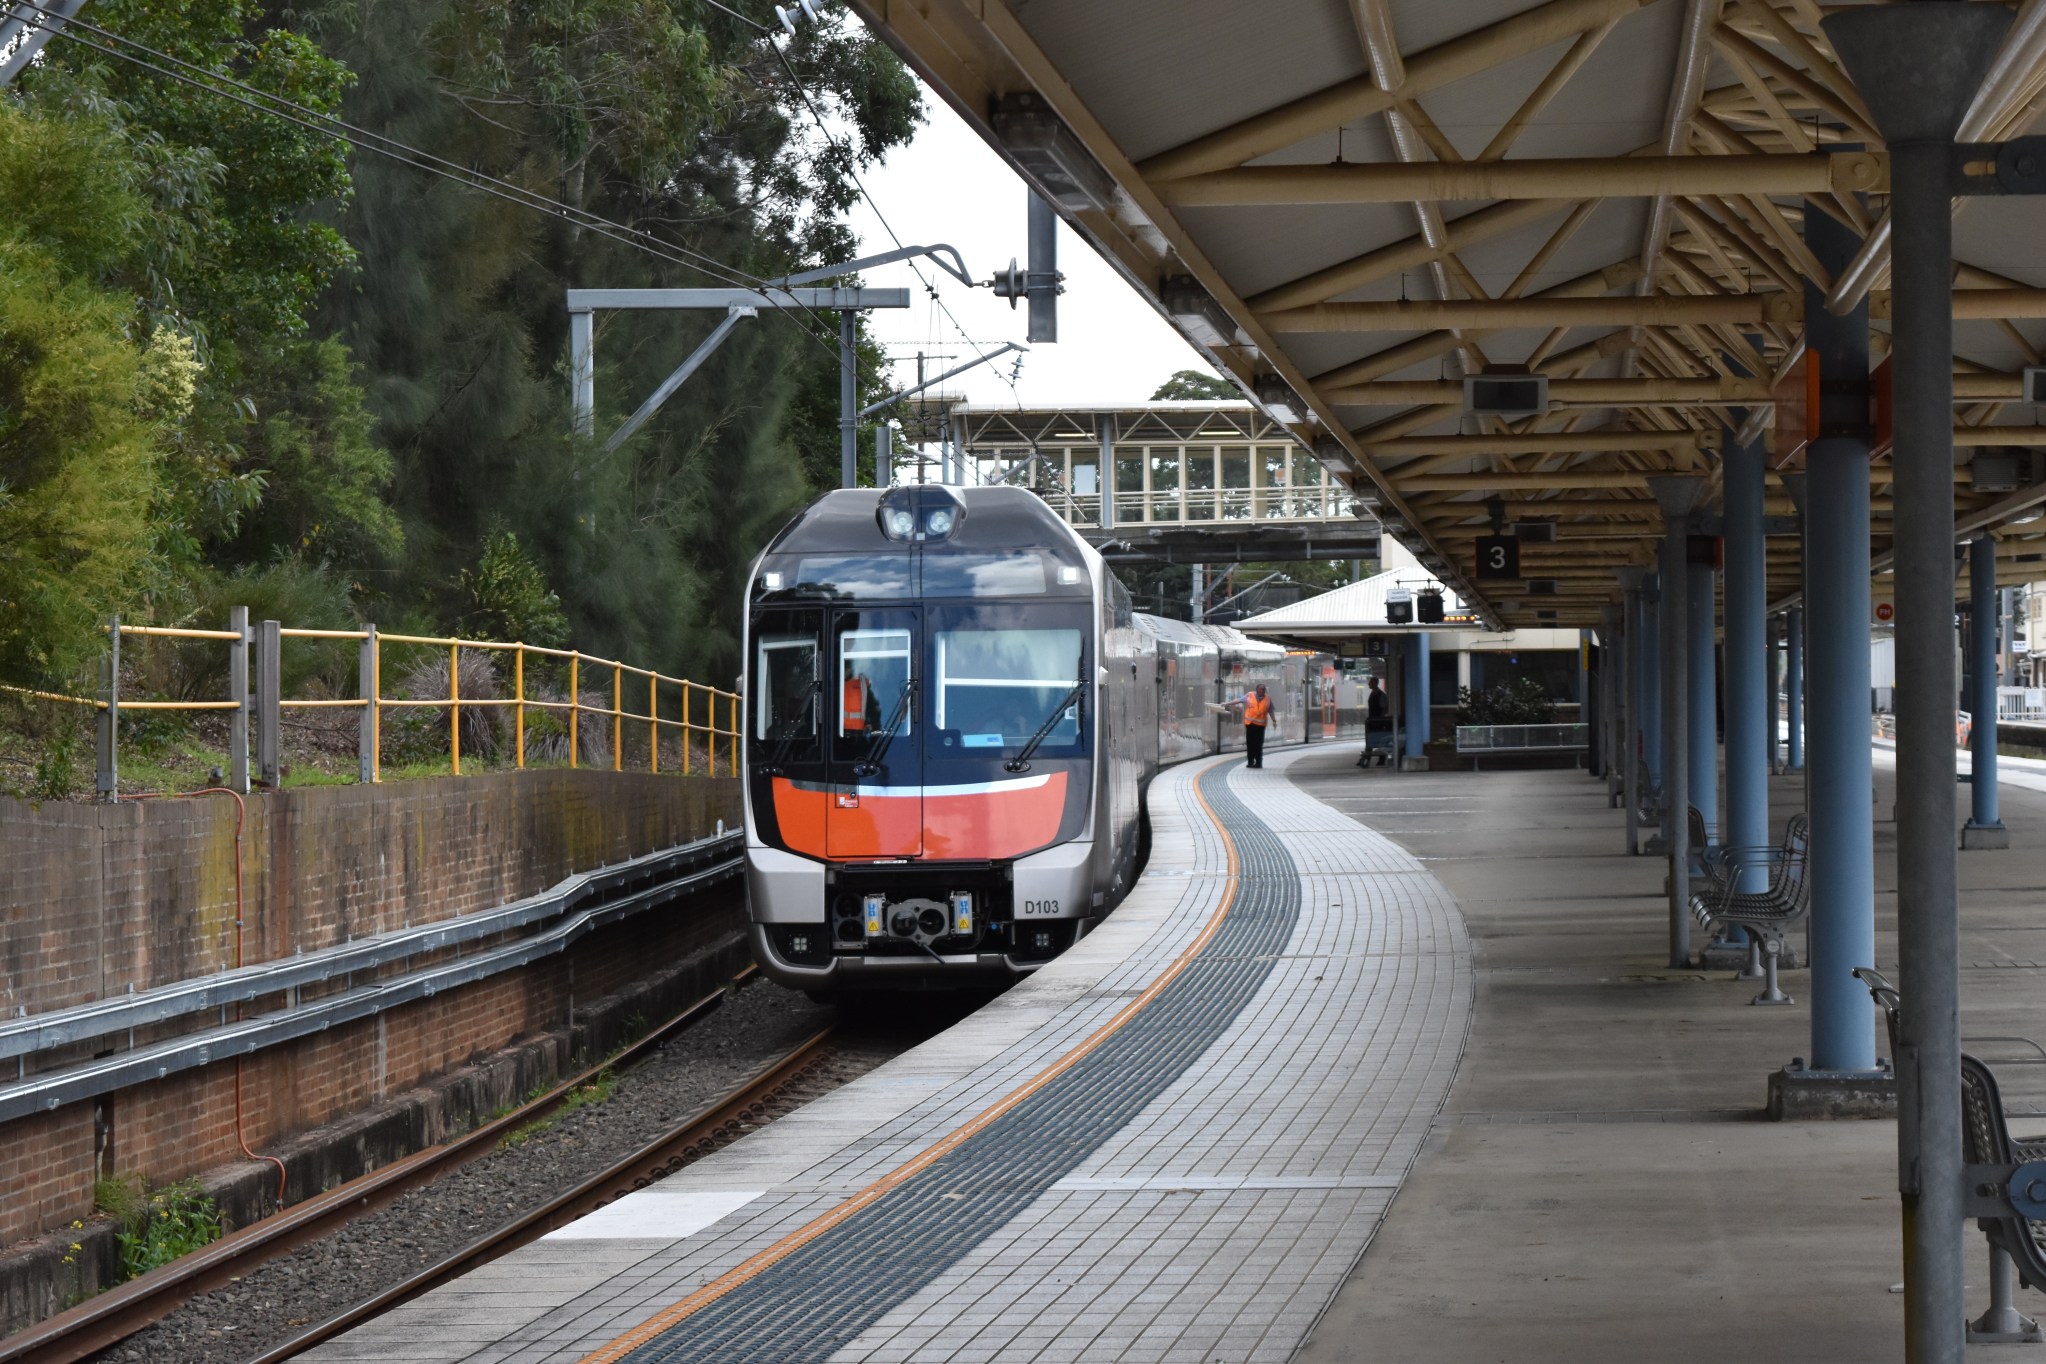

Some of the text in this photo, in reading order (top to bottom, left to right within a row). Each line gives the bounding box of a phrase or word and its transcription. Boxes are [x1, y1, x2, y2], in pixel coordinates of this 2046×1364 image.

[1490, 546, 1505, 569] 3
[1879, 608, 1891, 616] FH
[1372, 641, 1380, 651] 3
[1025, 900, 1060, 914] D103
